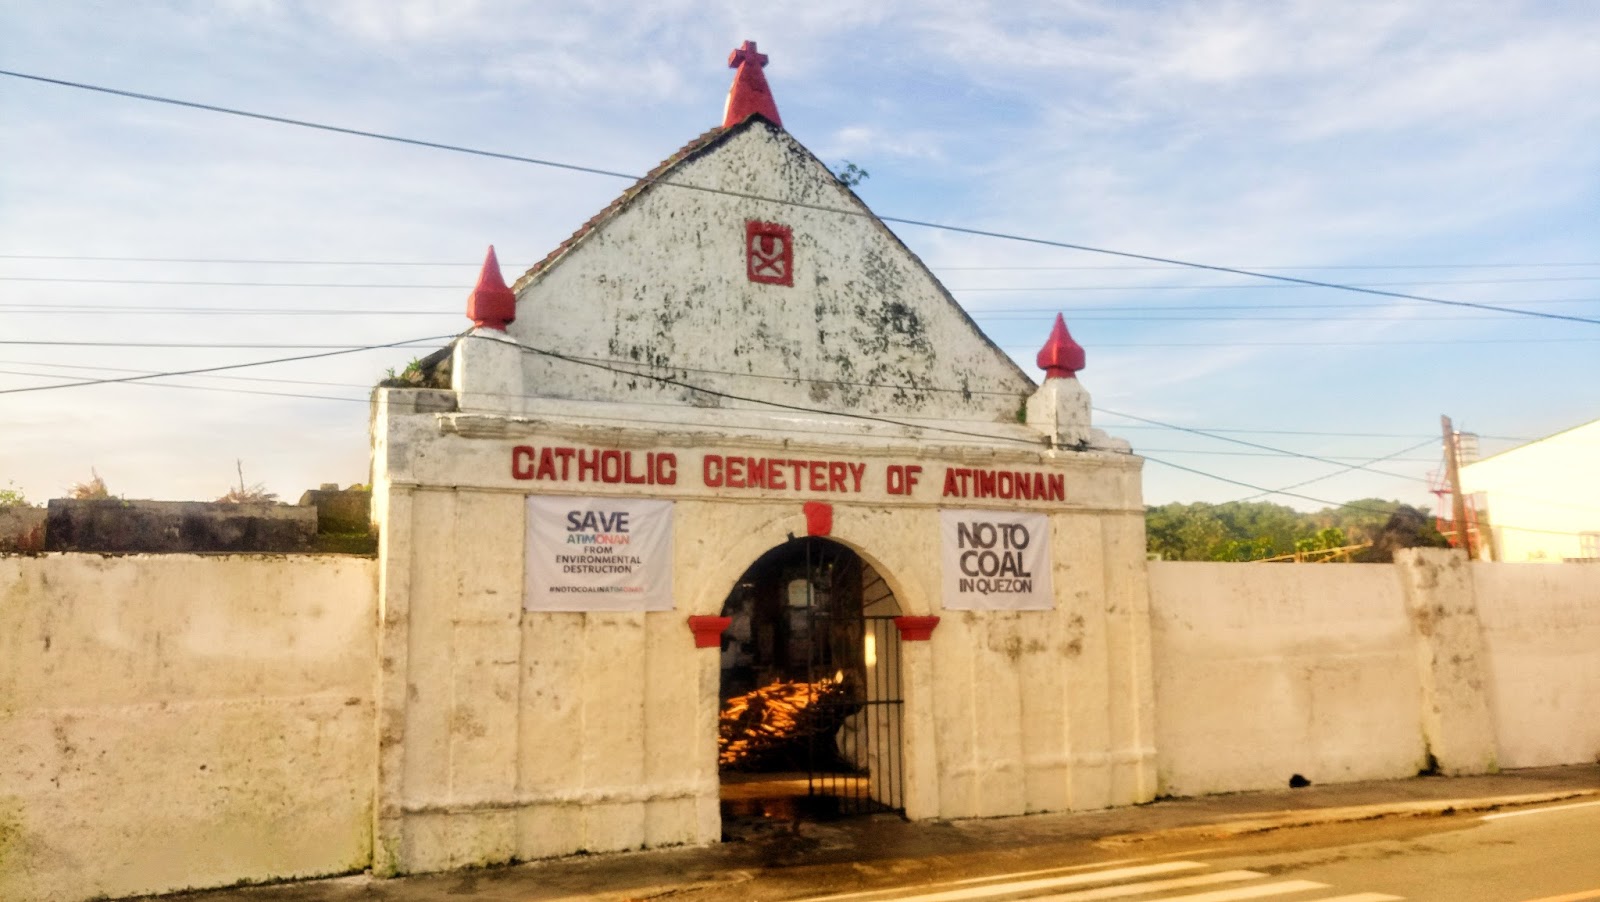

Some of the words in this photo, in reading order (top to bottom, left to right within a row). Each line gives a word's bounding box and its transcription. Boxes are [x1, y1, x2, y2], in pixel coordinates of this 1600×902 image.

[512, 445, 677, 485] CATHOLIC
[703, 454, 866, 493] CEMETERY
[886, 465, 923, 496] OF
[943, 467, 1065, 502] ATIMONAN
[567, 511, 630, 533] SAVE
[566, 533, 630, 545] ATIMONAN
[957, 522, 997, 549] NO
[998, 523, 1030, 550] TO
[584, 546, 613, 554] FROM
[555, 555, 642, 564] ENVIRONMENTAL
[959, 550, 1031, 578] COAL
[563, 565, 632, 574] DESTRUCTION
[959, 578, 974, 593] IN
[976, 578, 1032, 595] QUEZON
